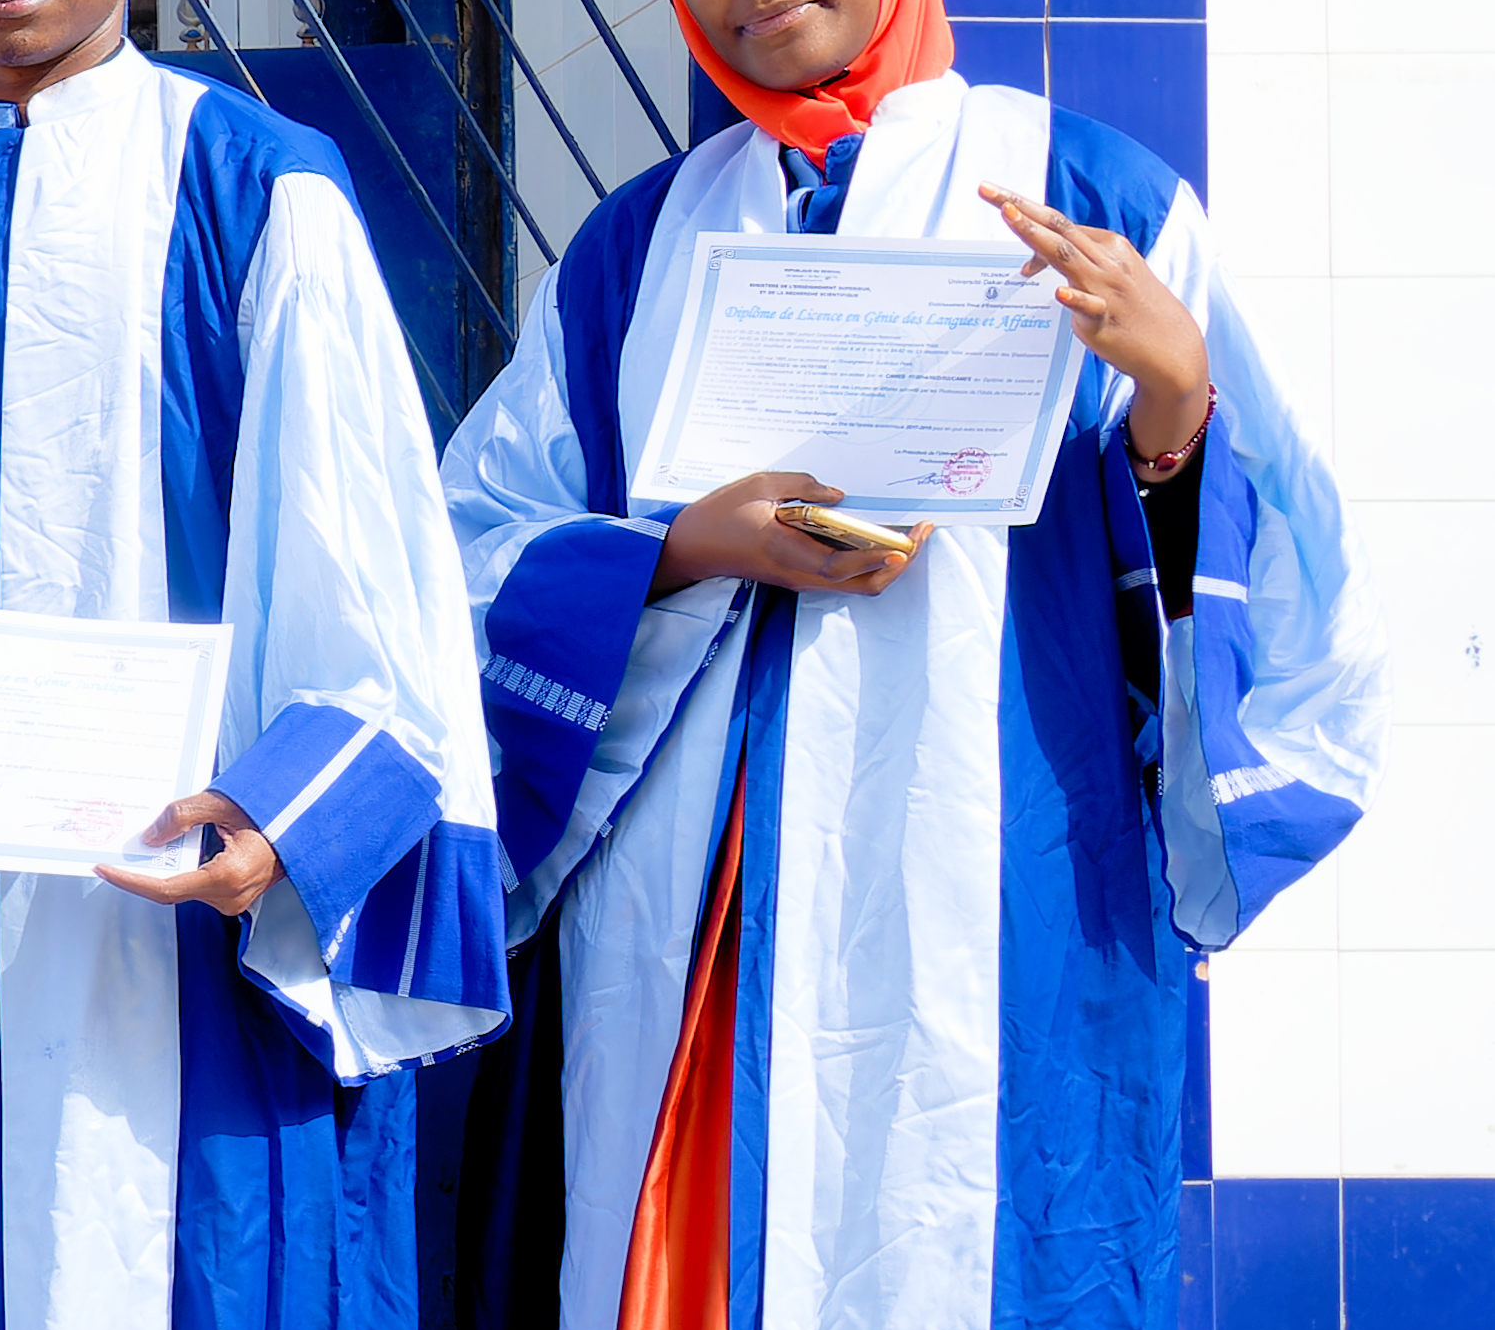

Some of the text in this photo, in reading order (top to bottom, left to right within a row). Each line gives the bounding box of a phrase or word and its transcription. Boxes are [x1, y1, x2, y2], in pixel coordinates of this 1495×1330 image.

[724, 305, 1053, 332] Diplôme de Licence en Génie des Langues et Affaires
